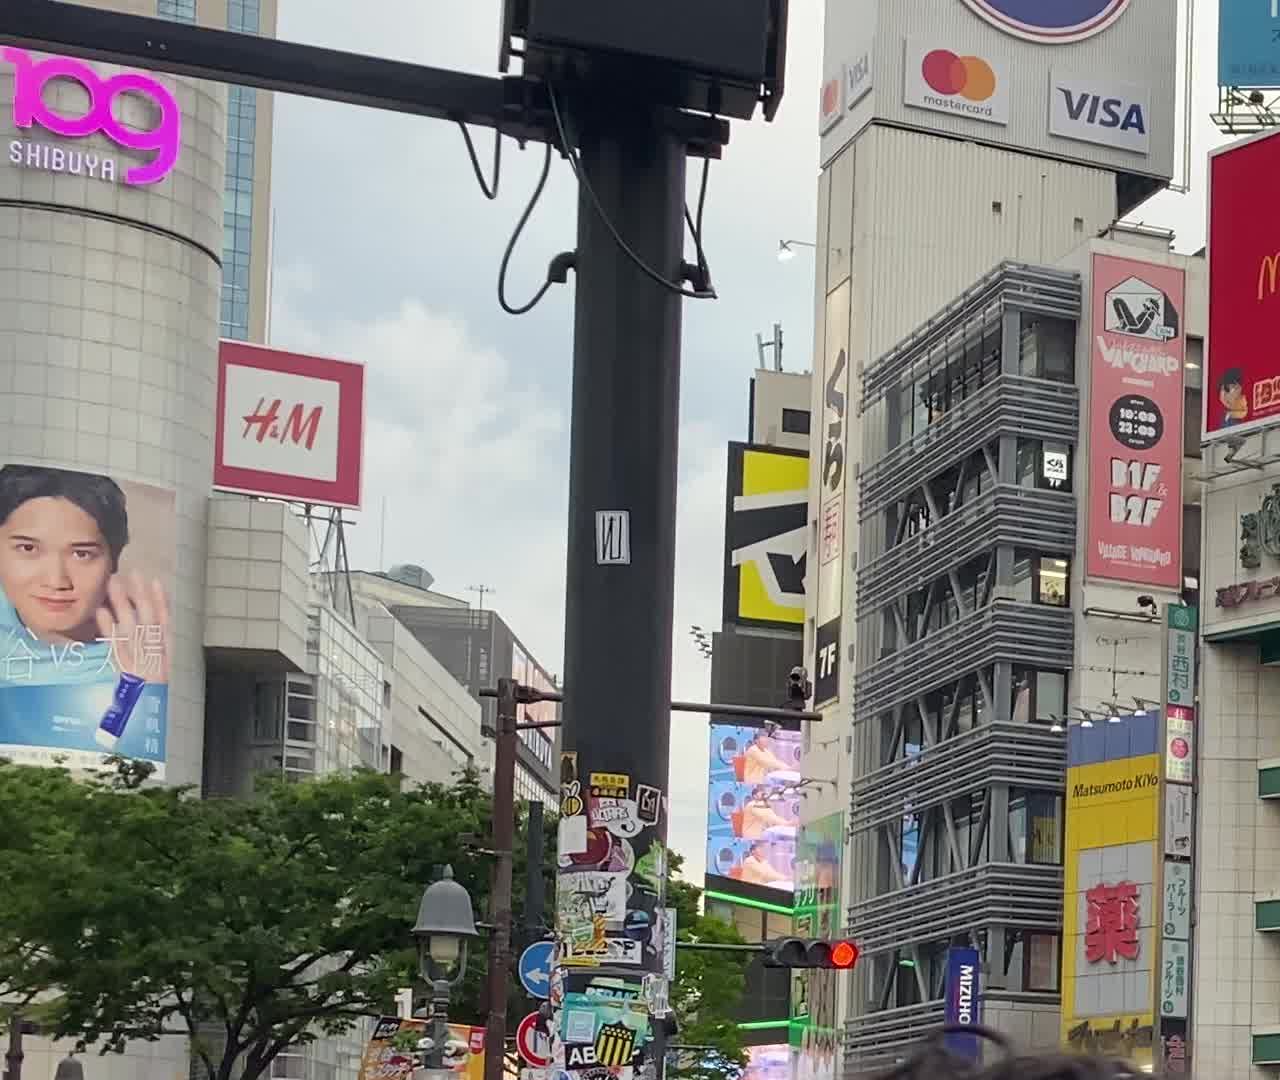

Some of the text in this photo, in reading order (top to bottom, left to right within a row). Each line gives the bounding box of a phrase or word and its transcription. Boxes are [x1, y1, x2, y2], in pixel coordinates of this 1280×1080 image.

[0, 46, 181, 185] 109
[923, 94, 993, 117] mastercard
[1056, 86, 1146, 134] VISA
[9, 140, 115, 182] SHIBUYA
[242, 397, 323, 451] H&M
[1110, 456, 1162, 492] B1F
[1109, 491, 1163, 528] B2F
[50, 640, 86, 668] VS
[95, 623, 163, 675] 太陽
[818, 642, 836, 678] 7F
[1072, 772, 1159, 800] Matsumoto KiYo
[1085, 880, 1142, 967] 薬
[958, 964, 974, 1025] MIZUHO
